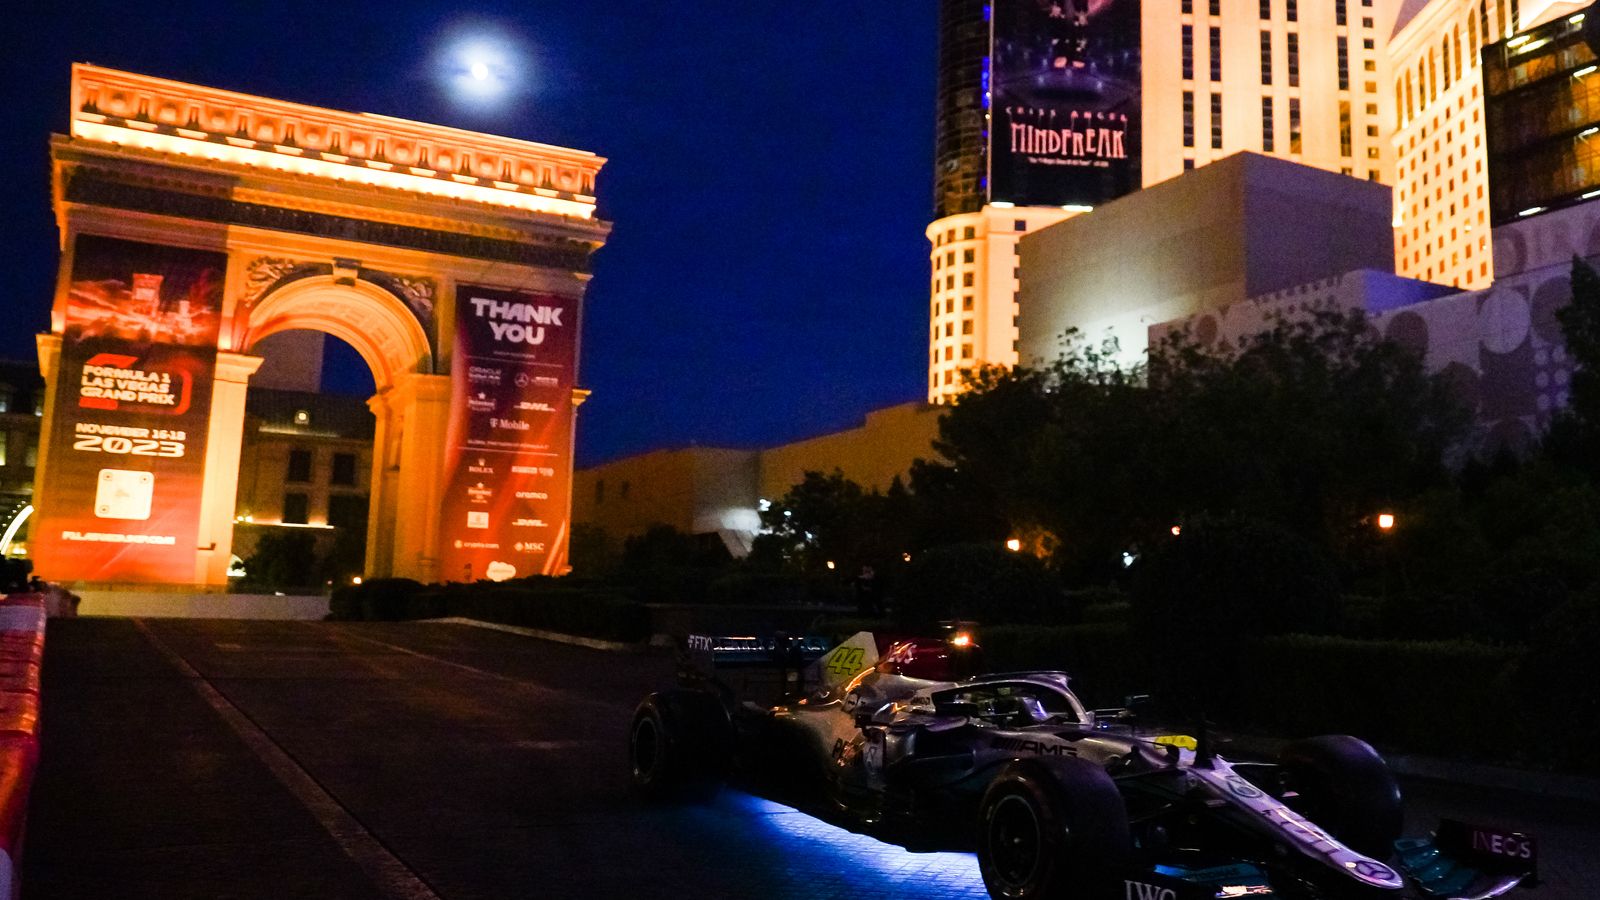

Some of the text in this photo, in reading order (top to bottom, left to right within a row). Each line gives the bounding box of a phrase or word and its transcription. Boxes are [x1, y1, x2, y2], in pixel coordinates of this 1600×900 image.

[1011, 122, 1127, 159] MINDFREAK
[470, 297, 563, 326] THANK
[489, 321, 545, 345] YOU
[82, 365, 171, 384] FORMULA 1
[81, 376, 169, 393] LAS VEGAS
[80, 387, 175, 405] GRAND PRIX
[75, 423, 186, 441] NOVEMBER 16-18
[500, 419, 530, 430] Mobile
[73, 434, 185, 457] 2023
[524, 542, 544, 551] MSC
[828, 647, 864, 674] 44
[1017, 740, 1078, 757] AMG
[1472, 830, 1531, 859] INEOS
